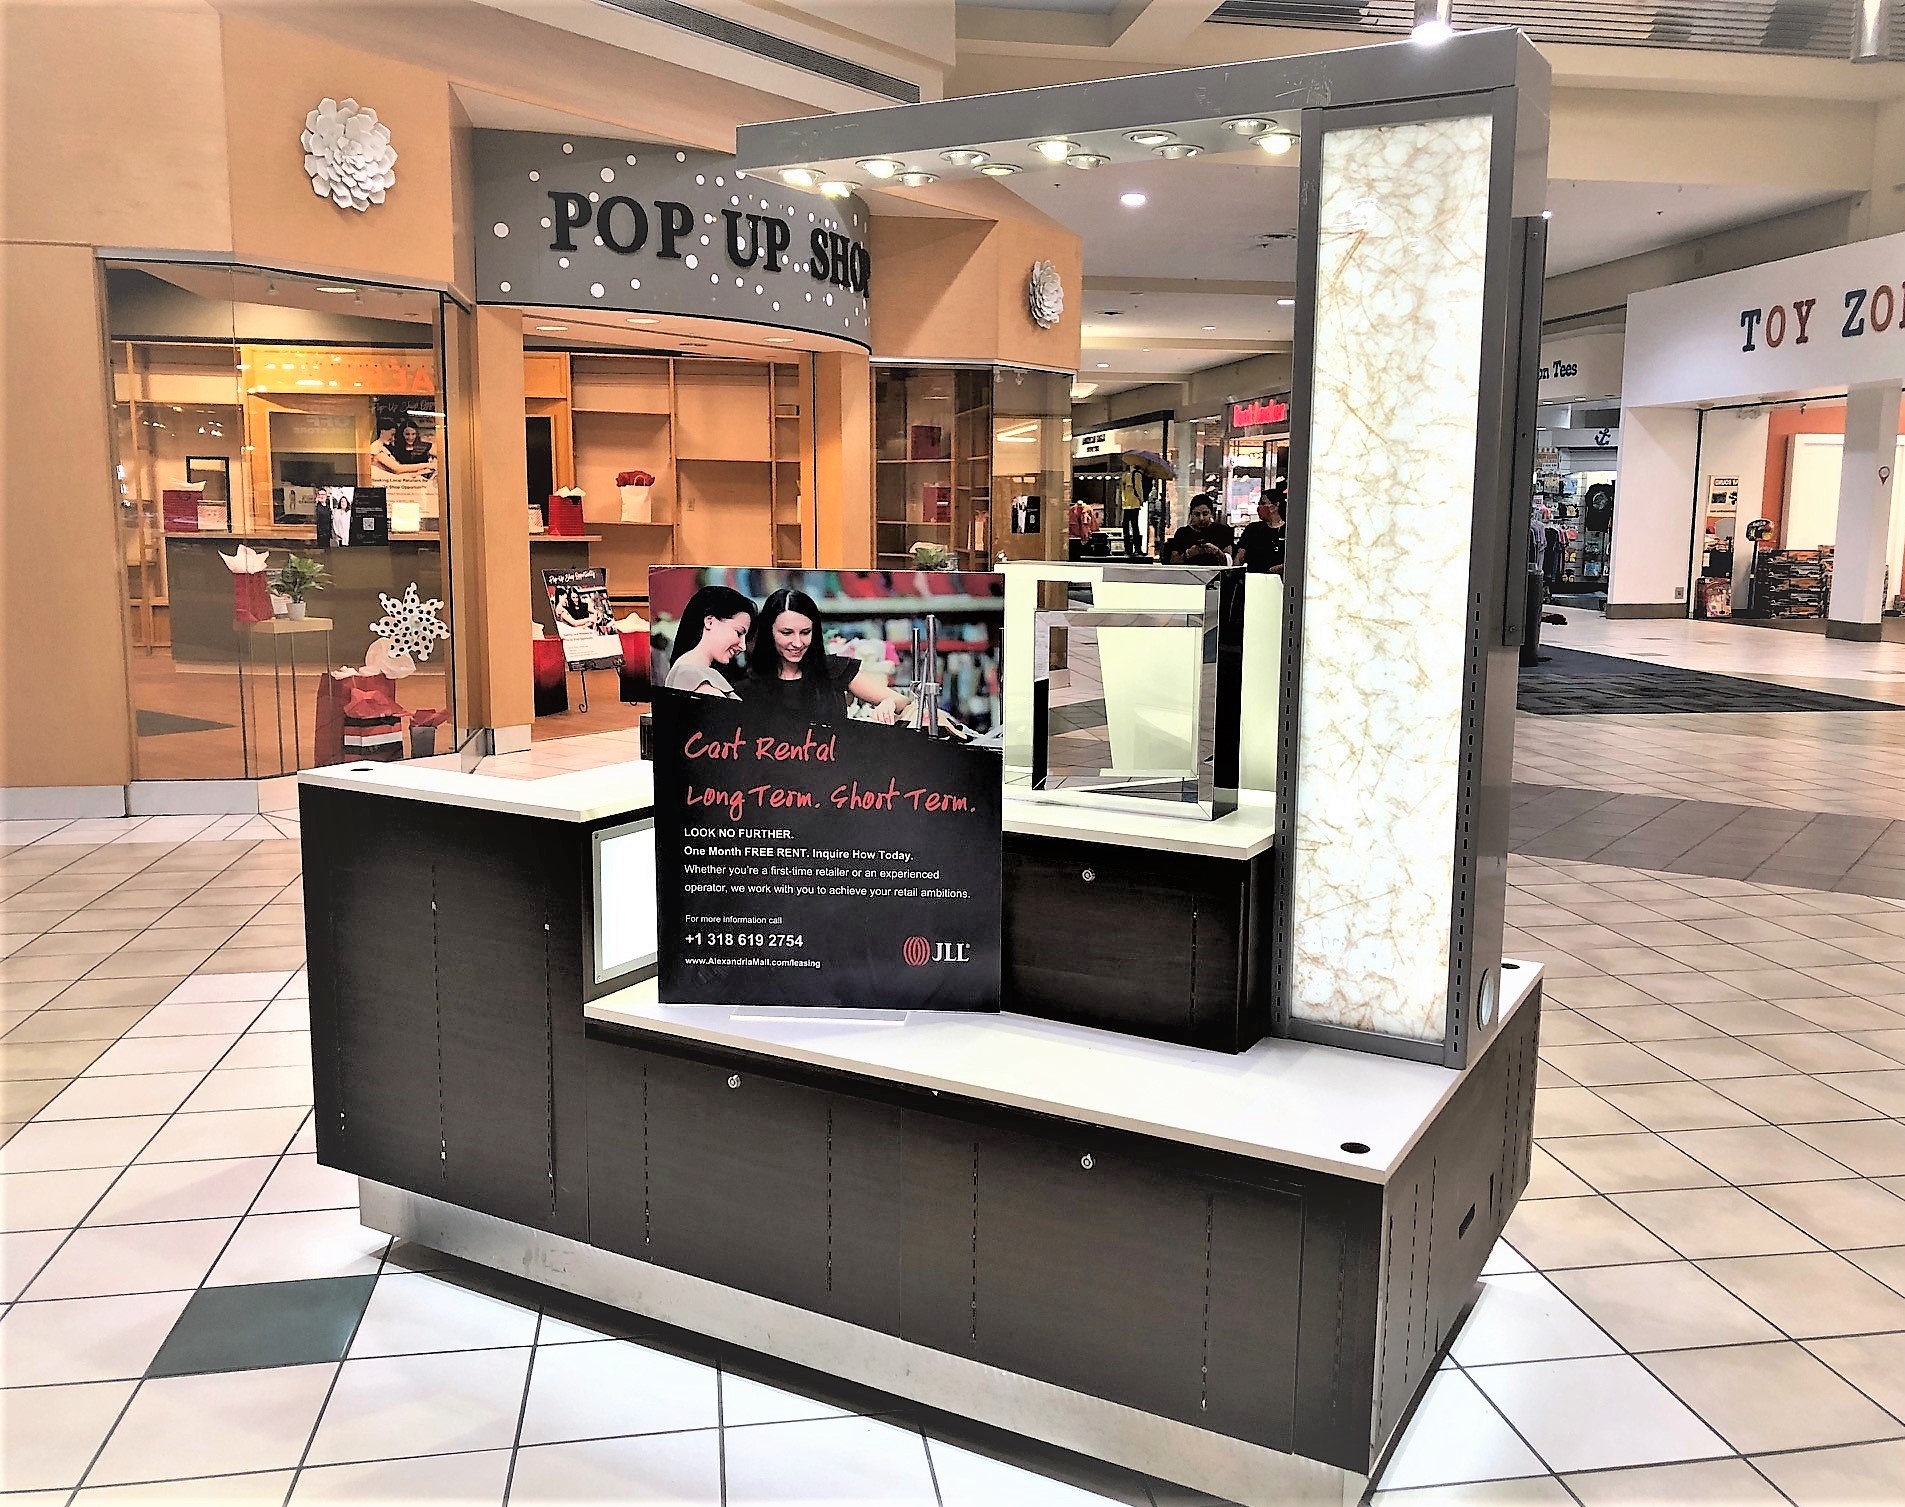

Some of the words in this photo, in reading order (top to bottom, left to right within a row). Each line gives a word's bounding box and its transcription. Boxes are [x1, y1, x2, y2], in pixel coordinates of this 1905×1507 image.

[547, 190, 695, 259] POP
[720, 208, 791, 273] UP
[1740, 298, 1816, 352] TOY
[1841, 281, 1905, 338] ZO
[1552, 360, 1578, 378] Tees
[684, 726, 747, 760] Cart
[755, 728, 836, 762] Rental
[686, 785, 746, 822] Long
[748, 784, 821, 809] Term.
[830, 776, 901, 811] Short
[903, 788, 976, 813] Term.
[684, 827, 716, 838] LOOK
[718, 828, 736, 838] NO
[738, 829, 795, 839] FURTHER.
[684, 845, 706, 856] One
[708, 846, 742, 857] Month
[744, 847, 774, 857] FREE
[776, 848, 810, 858] RENT.
[812, 848, 850, 860] Inquire
[852, 849, 876, 859] How
[878, 850, 914, 862] Today.
[684, 864, 726, 874] Whether
[728, 865, 759, 877] you're
[761, 867, 768, 875] a
[770, 865, 813, 876] first-time
[815, 866, 850, 877] retailer
[851, 869, 862, 877] or
[864, 869, 877, 878] an
[879, 869, 940, 880] experienced
[684, 883, 728, 894] operator,
[730, 885, 746, 893] we
[747, 884, 772, 894] work
[773, 884, 794, 894] with
[796, 885, 815, 897] you
[816, 885, 827, 894] to
[828, 885, 868, 895] achieve
[869, 887, 892, 898] your
[893, 887, 918, 897] retail
[920, 888, 971, 899] ambitions.
[685, 914, 700, 923] For
[700, 915, 721, 924] more
[722, 915, 767, 924] information
[768, 916, 782, 924] call
[685, 932, 702, 945] +1
[707, 933, 734, 946] 318
[737, 933, 764, 947] 619
[768, 934, 804, 948] 2754
[931, 942, 970, 962] JLL
[684, 957, 821, 969] www.AlexandriaMall.com/leasing
